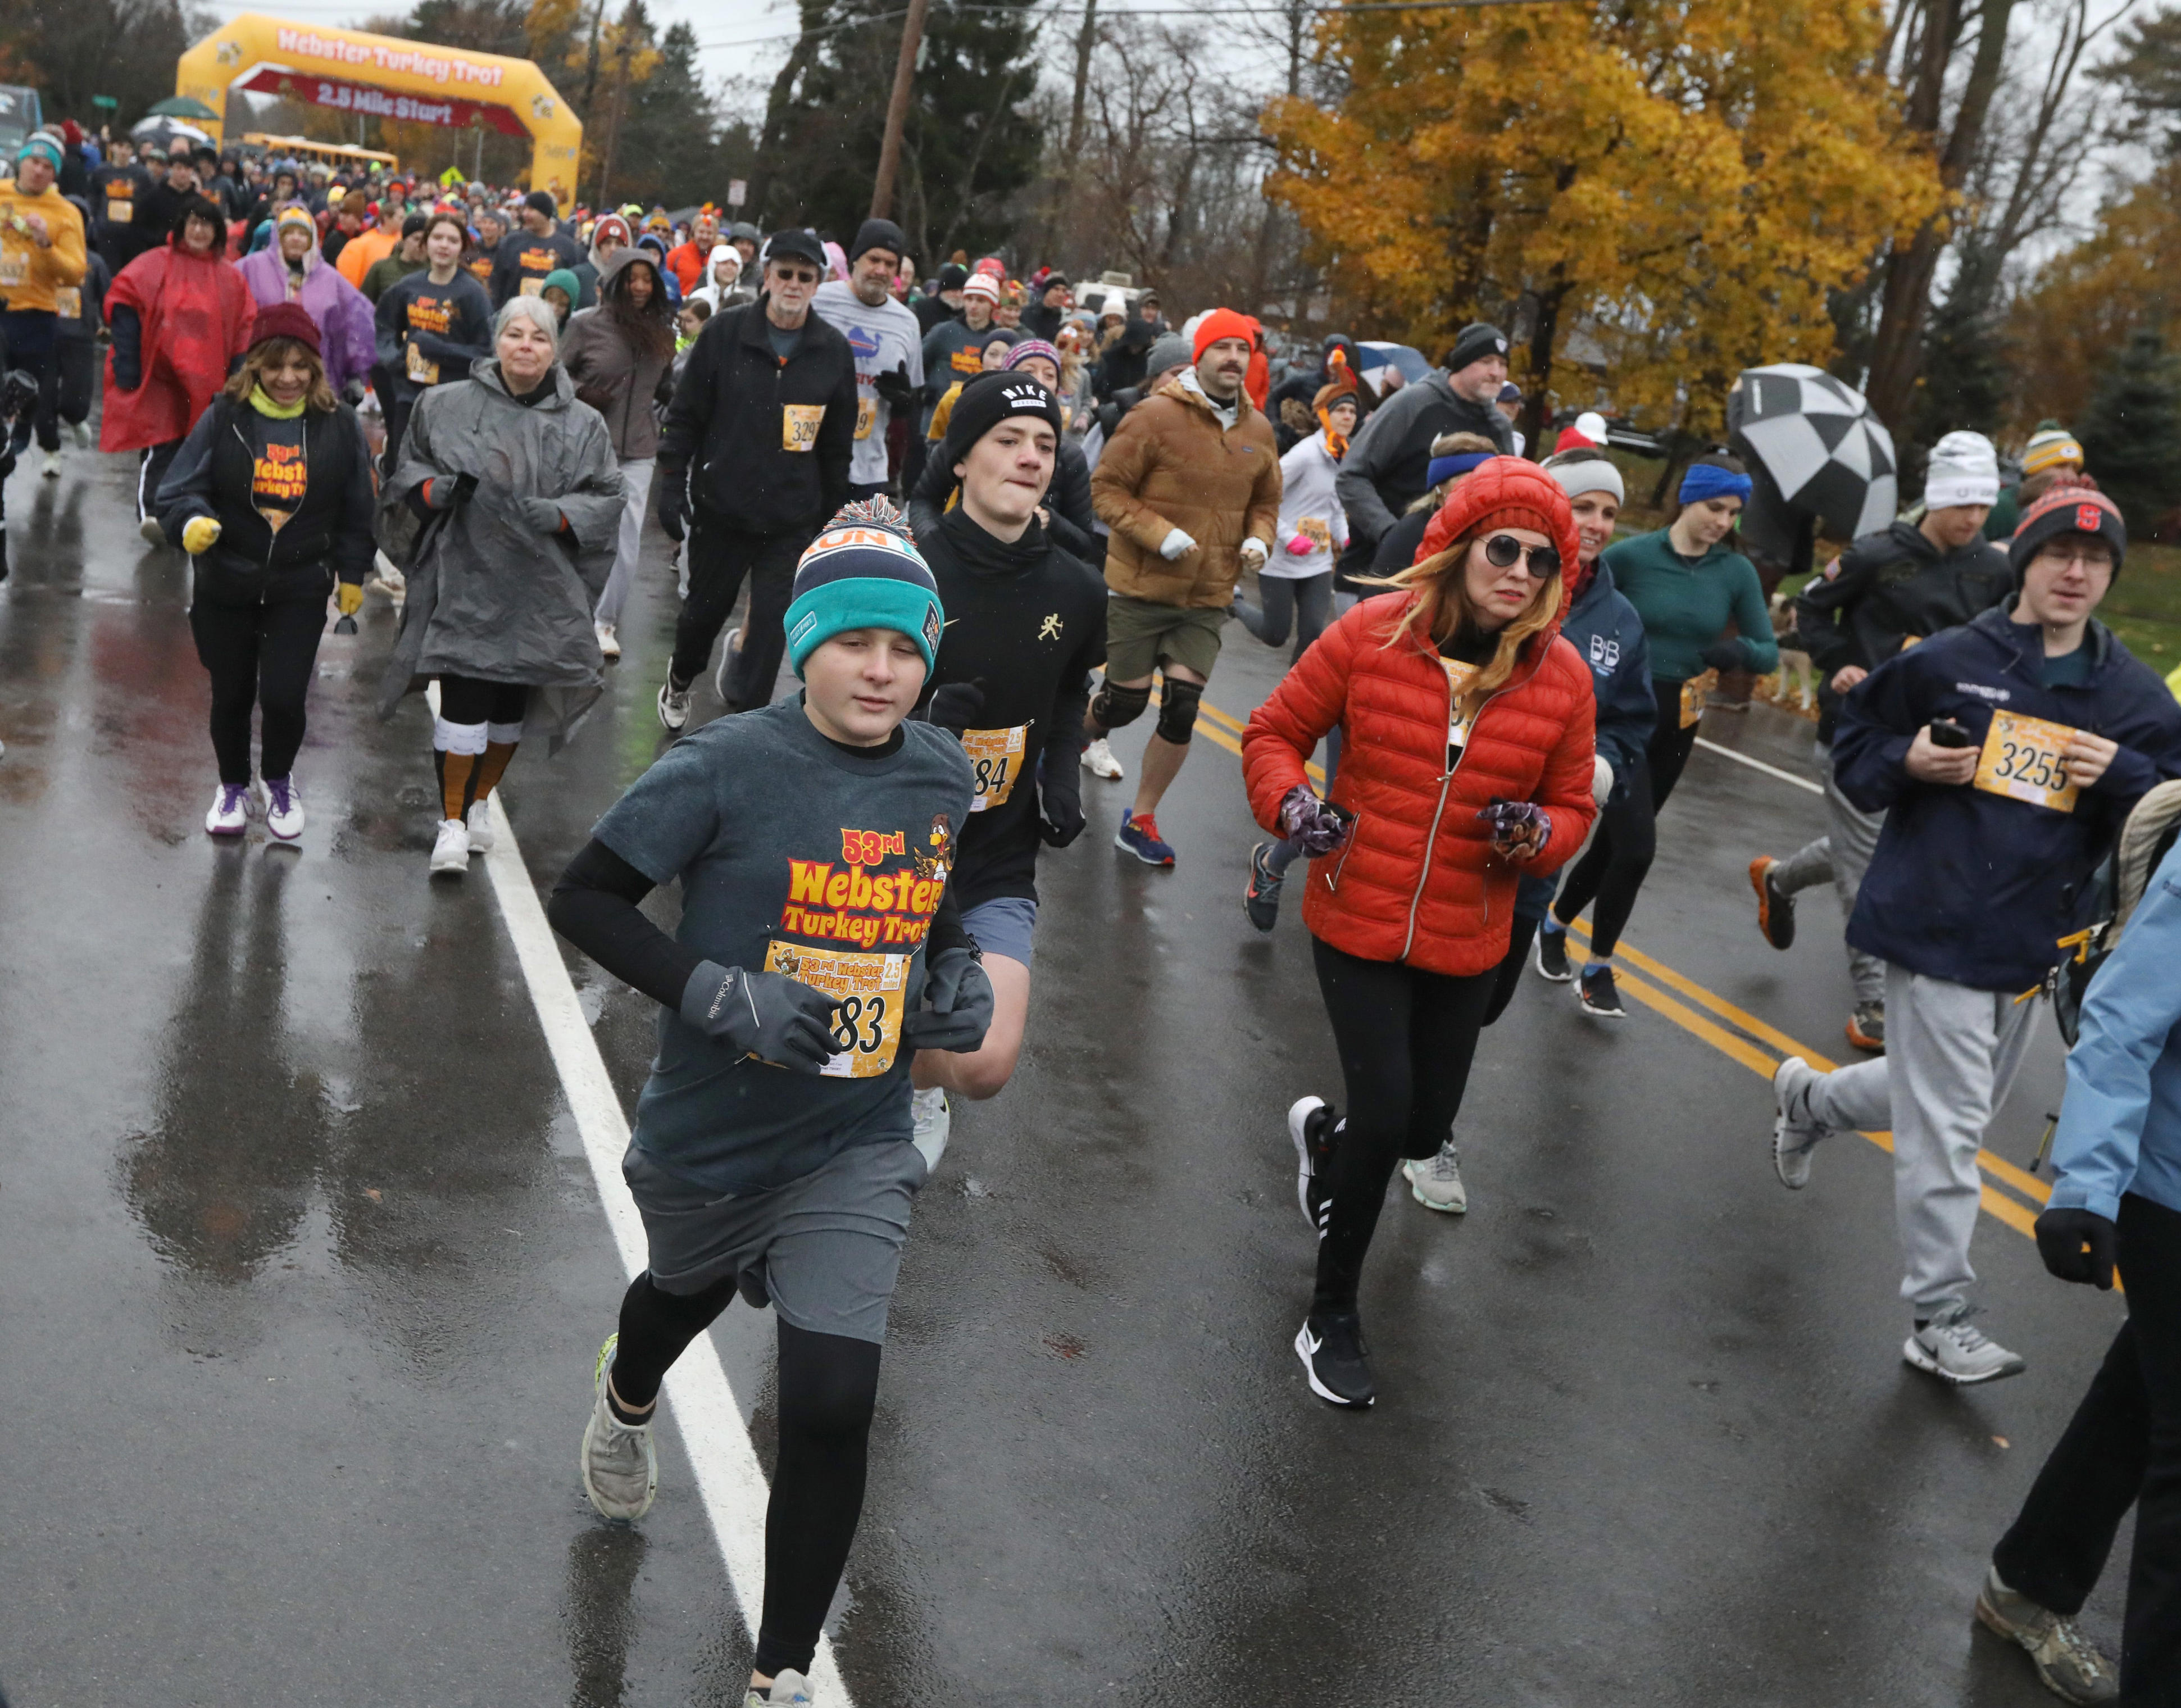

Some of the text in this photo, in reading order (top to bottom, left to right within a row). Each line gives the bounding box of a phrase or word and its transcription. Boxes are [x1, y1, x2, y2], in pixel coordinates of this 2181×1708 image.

[278, 28, 504, 86] Webster Turkey Trot
[353, 88, 394, 116] Mile
[395, 97, 452, 124] Start
[1002, 384, 1047, 401] NIKE
[793, 421, 821, 441] 329
[858, 412, 868, 430] 9
[255, 457, 307, 481] ebst
[2075, 503, 2101, 532] S
[1010, 733, 1021, 745] 2.5
[970, 757, 1008, 796] 84
[1996, 742, 2070, 791] 3255
[840, 828, 906, 866] 53rd
[788, 857, 944, 914] Webster
[780, 902, 932, 950] Turkey Trot
[798, 970, 898, 994] Turkey Trot miles
[837, 962, 884, 977] Webster
[885, 962, 899, 979] 2.5
[707, 982, 729, 1019] Columbia
